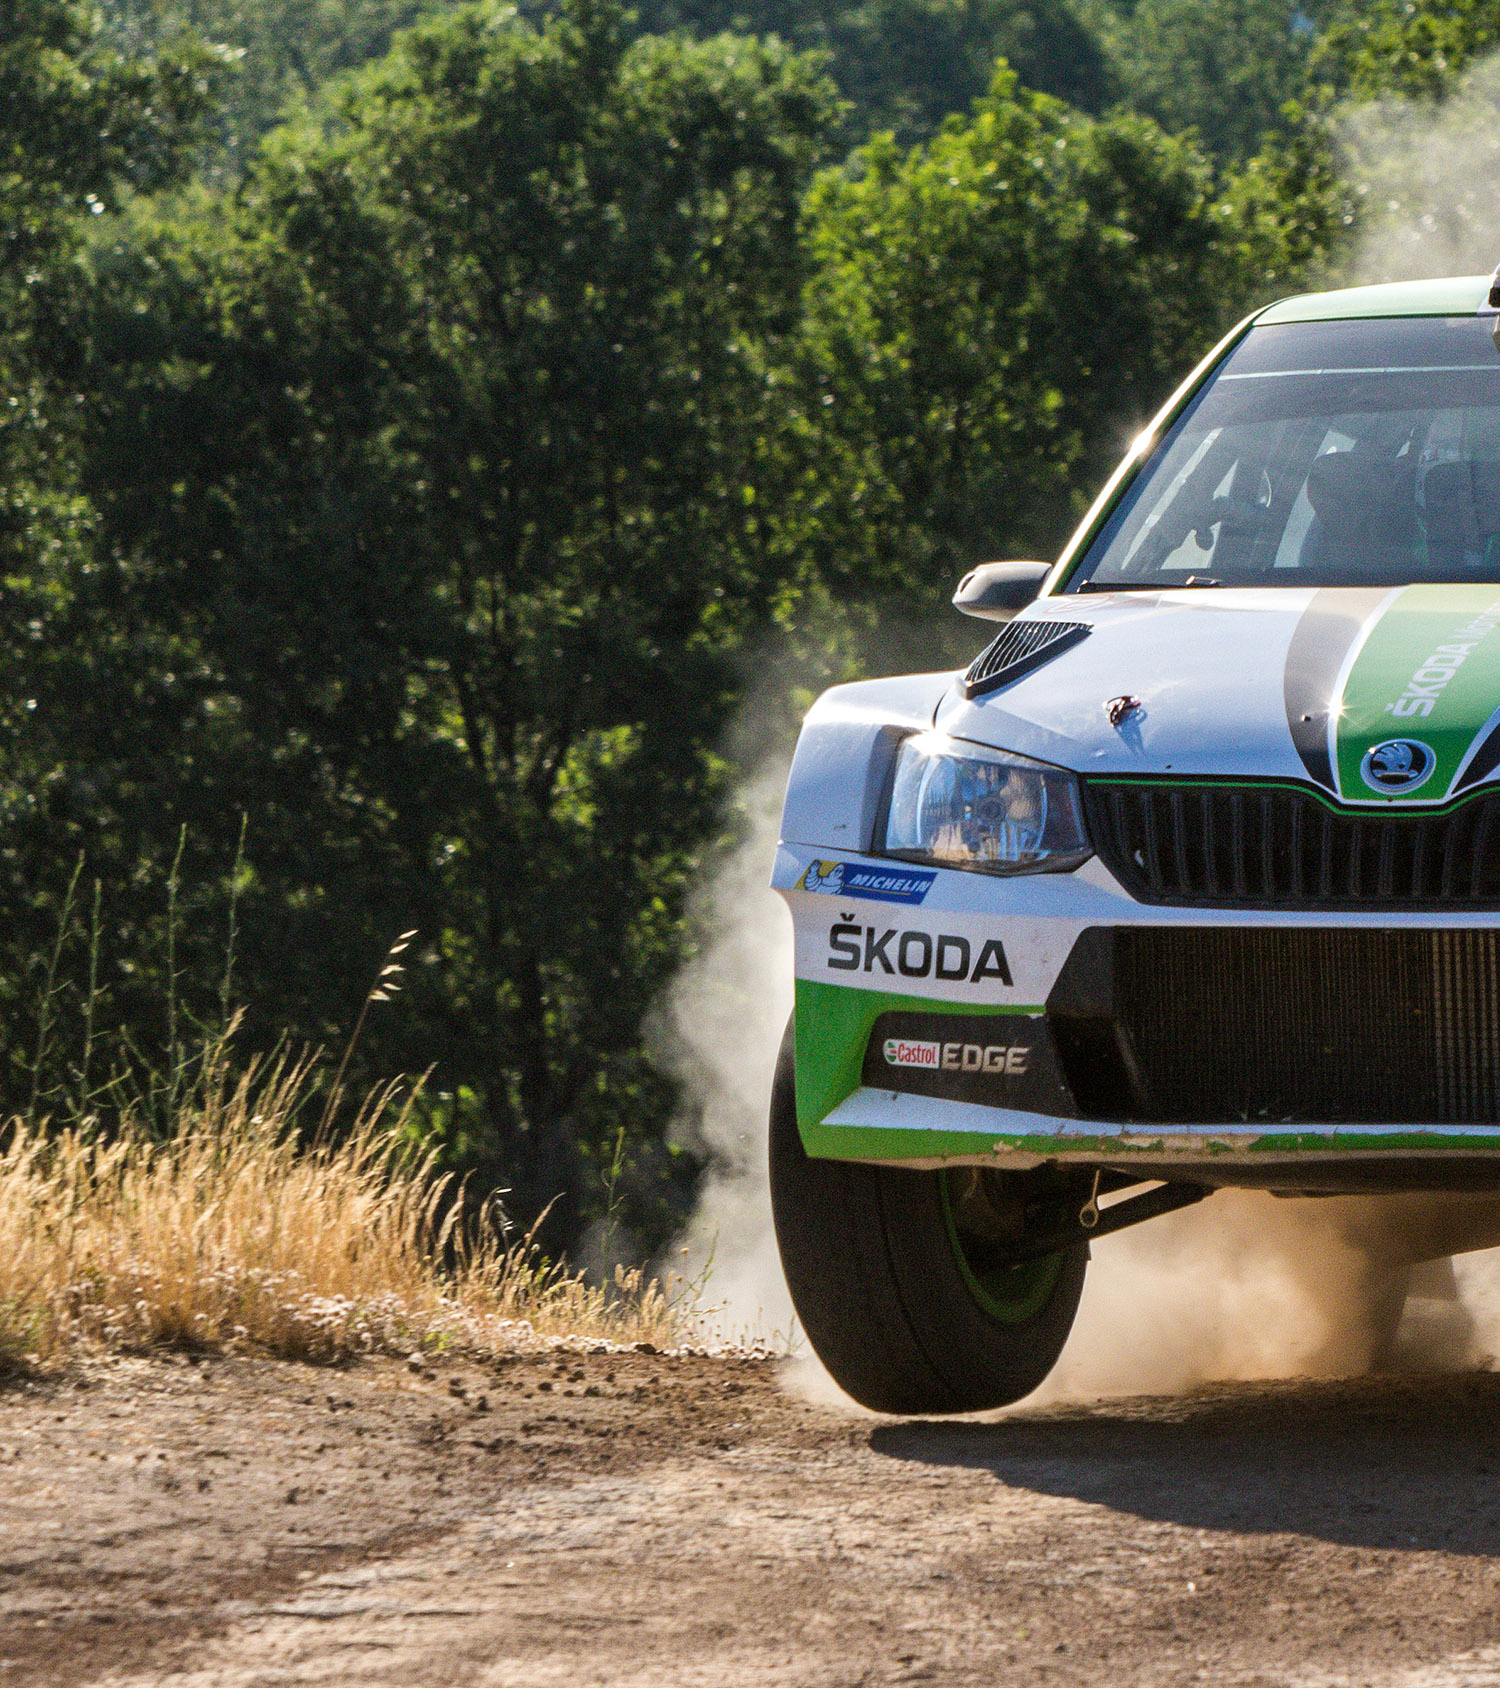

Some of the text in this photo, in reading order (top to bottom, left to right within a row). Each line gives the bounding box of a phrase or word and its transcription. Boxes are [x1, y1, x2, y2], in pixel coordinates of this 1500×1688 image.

[1384, 642, 1479, 718] ŠKODA
[848, 873, 932, 893] MICHELIN
[827, 912, 1014, 988] ŠKODA
[897, 1042, 1032, 1074] Castrol EDGE
